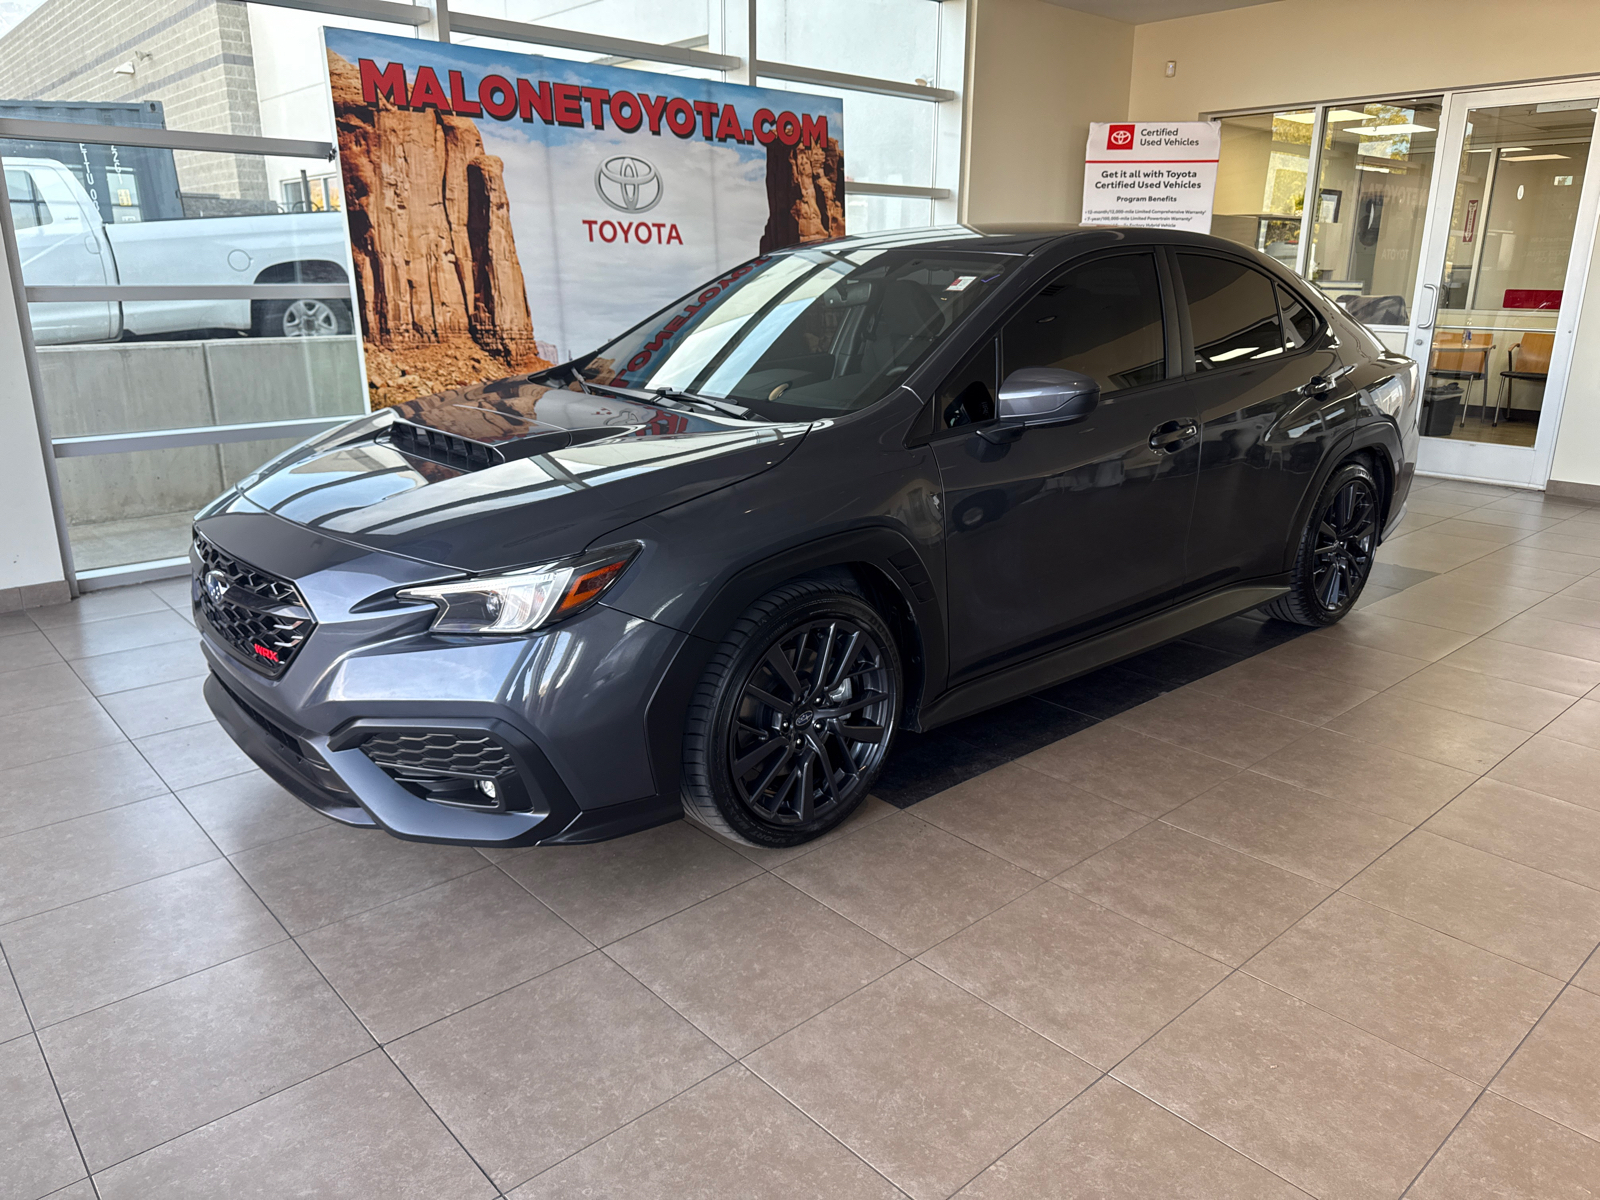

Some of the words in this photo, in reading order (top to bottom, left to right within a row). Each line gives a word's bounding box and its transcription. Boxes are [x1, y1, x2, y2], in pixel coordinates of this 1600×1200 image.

[358, 58, 828, 150] MALONETOYOTA.COM
[1140, 128, 1179, 136] Certified
[1164, 138, 1199, 146] Vehicles
[1101, 170, 1118, 178] Get
[1120, 170, 1127, 178] it
[1129, 170, 1141, 178] all
[1143, 170, 1164, 178] with
[1166, 170, 1197, 180] Toyota
[1095, 181, 1136, 189] Certified
[1137, 181, 1161, 189] Used
[1163, 180, 1201, 189] Vehicles
[1116, 196, 1147, 204] Program
[582, 219, 684, 246] TOYOTA
[254, 643, 279, 663] WRX
